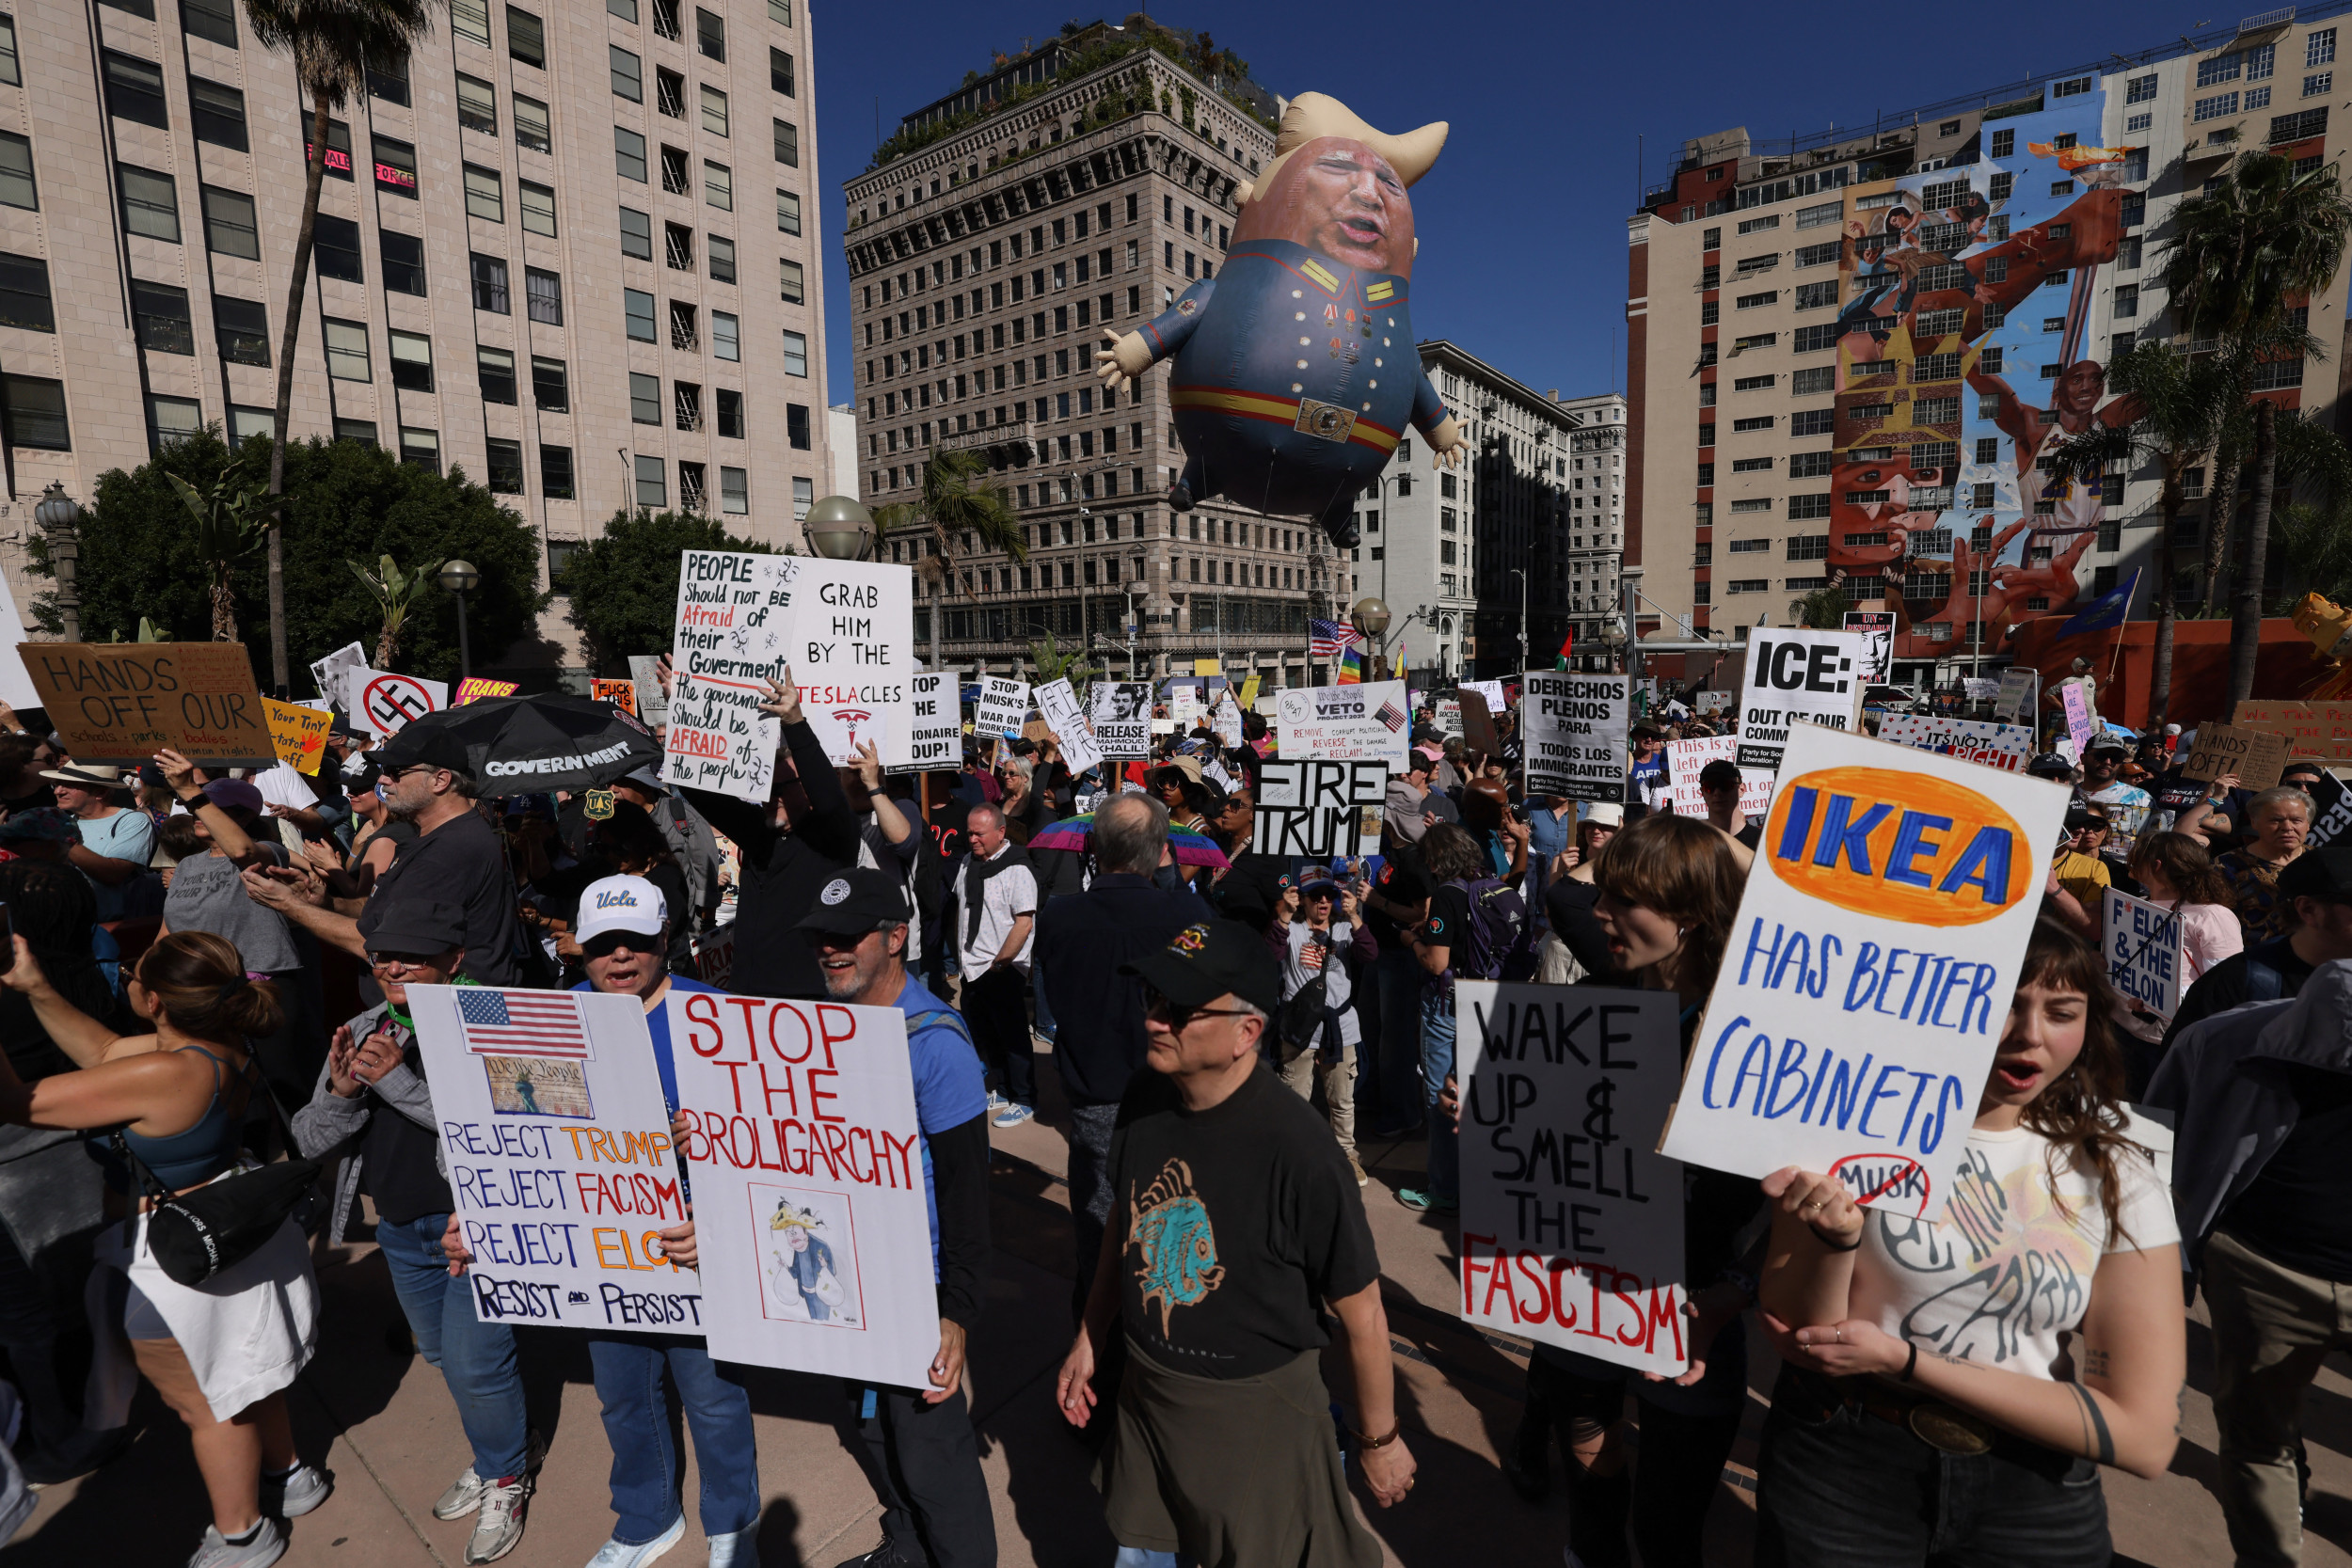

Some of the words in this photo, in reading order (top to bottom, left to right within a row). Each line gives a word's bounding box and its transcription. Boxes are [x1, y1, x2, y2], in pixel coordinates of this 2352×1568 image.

[688, 553, 754, 582] PEOPLE
[684, 583, 727, 603] Should
[769, 591, 791, 607] BE
[819, 583, 878, 609] GRAB
[681, 605, 734, 627] Afraid
[747, 607, 769, 627] of
[833, 616, 871, 638] HIM
[680, 626, 723, 650] their
[808, 641, 835, 663] BY
[851, 643, 891, 665] THE
[41, 657, 178, 692] HANDS
[1755, 641, 1851, 693] ICE:
[460, 678, 516, 697] TRANS
[598, 683, 630, 694] FUCK
[676, 671, 698, 701] the
[797, 685, 901, 704] TESLACLES
[991, 680, 1019, 694] STOP
[1485, 683, 1496, 691] off
[1529, 678, 1624, 700] DERECHOS
[80, 696, 158, 728] OFF
[182, 692, 258, 731] OUR
[983, 693, 1025, 709] MUSK'S
[1285, 701, 1295, 710] 86
[1316, 702, 1366, 715] VETO
[1541, 699, 1610, 720] PLENOS
[273, 707, 295, 722] Your
[729, 710, 749, 736] be
[980, 711, 1004, 722] WAR
[1007, 715, 1021, 725] ON
[1292, 707, 1302, 718] 47
[1748, 708, 1781, 725] OUT
[1813, 713, 1847, 730] OUR
[2245, 709, 2269, 720] WE
[2281, 709, 2316, 720] THE
[70, 731, 118, 743] schools
[132, 730, 167, 745] parks
[183, 730, 228, 744] bodies
[1096, 725, 1145, 738] RELEASE
[1294, 728, 1324, 738] REMOVE
[1558, 720, 1591, 735] PARA
[2292, 727, 2321, 737] THE
[670, 728, 727, 755] AFRAID
[736, 744, 758, 765] of
[1098, 744, 1144, 752] KHALIL!
[1312, 738, 1346, 748] REVERSE
[1539, 742, 1581, 759] TODOS
[1585, 748, 1612, 761] LOS
[1710, 737, 1721, 750] is
[1951, 734, 1992, 749] NOT
[2199, 733, 2249, 753] HANDS
[485, 741, 632, 777] GOVERNMENT
[1329, 748, 1363, 758] RECLAIM
[1374, 750, 1403, 759] Democracy
[1676, 756, 1699, 770] left
[1741, 755, 1773, 765] Liberation
[1742, 749, 1759, 757] Party
[1952, 746, 2019, 771] RIGHT
[2189, 752, 2238, 776] OFF!
[673, 755, 693, 780] the
[698, 756, 746, 789] people
[1529, 758, 1623, 779] IMMIGRANTES
[1255, 760, 1389, 809] FIRE
[1532, 784, 1559, 792] Liberation
[1556, 780, 1581, 788] Socialism
[1676, 788, 1686, 800] It
[1777, 786, 2012, 905] IKEA
[2115, 932, 2130, 959] &
[2137, 940, 2171, 982] THE
[1739, 917, 1842, 999] HAS
[1843, 942, 1996, 1035] BETTER
[2111, 960, 2164, 1011] FELON
[685, 994, 856, 1069] STOP
[1474, 1002, 1640, 1069] WAKE
[536, 1059, 581, 1081] People
[712, 1060, 846, 1123] THE
[1702, 1015, 1963, 1155] CABINETS
[1470, 1072, 1537, 1127] UP
[1582, 1076, 1619, 1146] &
[444, 1122, 553, 1160] REJECT
[559, 1127, 672, 1166] TRUMP
[681, 1108, 917, 1191] BROLIGARCHY
[1491, 1126, 1649, 1203] SMELL
[1838, 1160, 1926, 1198] MUSK
[454, 1165, 566, 1210] REJECT
[576, 1172, 685, 1222] FACISM
[189, 1214, 206, 1231] KORS
[1505, 1190, 1605, 1254] THE
[466, 1220, 580, 1268] REJECT
[472, 1274, 561, 1320] RESIST
[567, 1290, 588, 1303] AND
[599, 1282, 703, 1326] PERSIST
[1464, 1232, 1685, 1361] FASCISM
